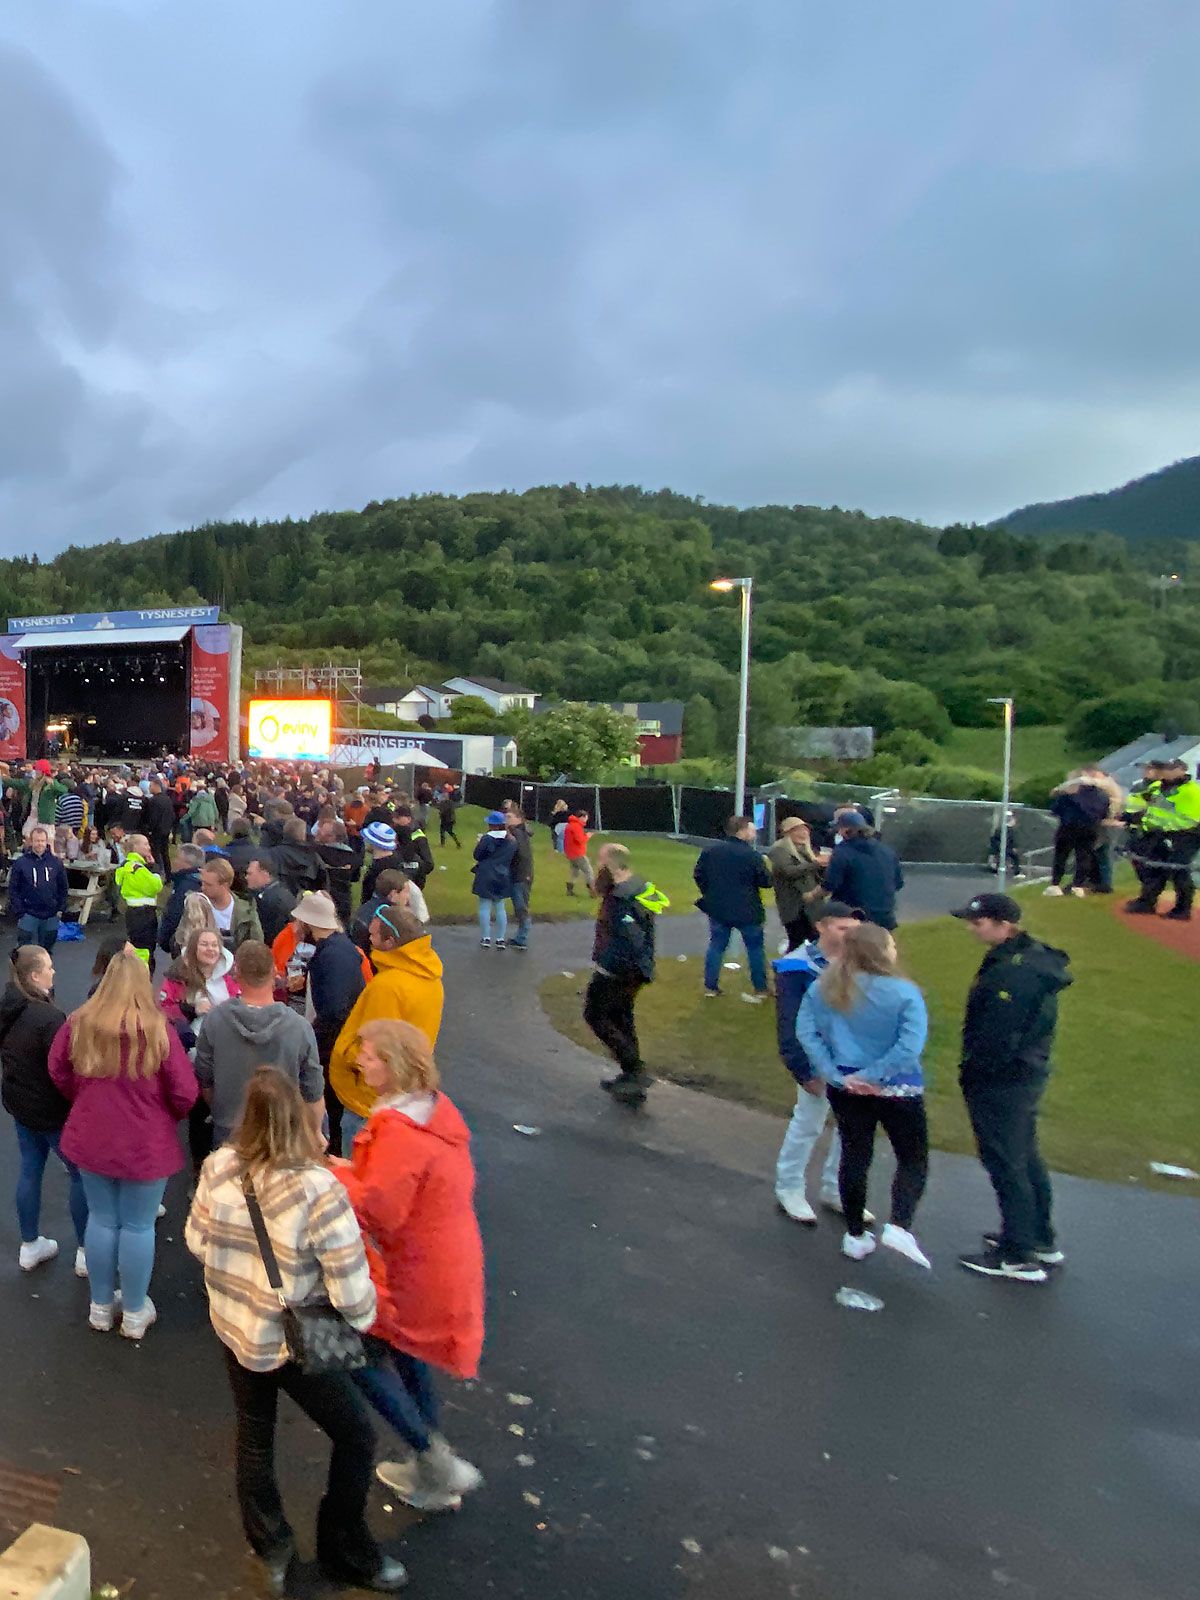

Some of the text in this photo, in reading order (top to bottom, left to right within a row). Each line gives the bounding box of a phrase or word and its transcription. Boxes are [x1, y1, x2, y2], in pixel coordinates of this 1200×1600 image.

[138, 608, 214, 621] TYSNESFEST
[11, 615, 75, 628] TYSNESFEST
[361, 736, 425, 750] KONSERT
